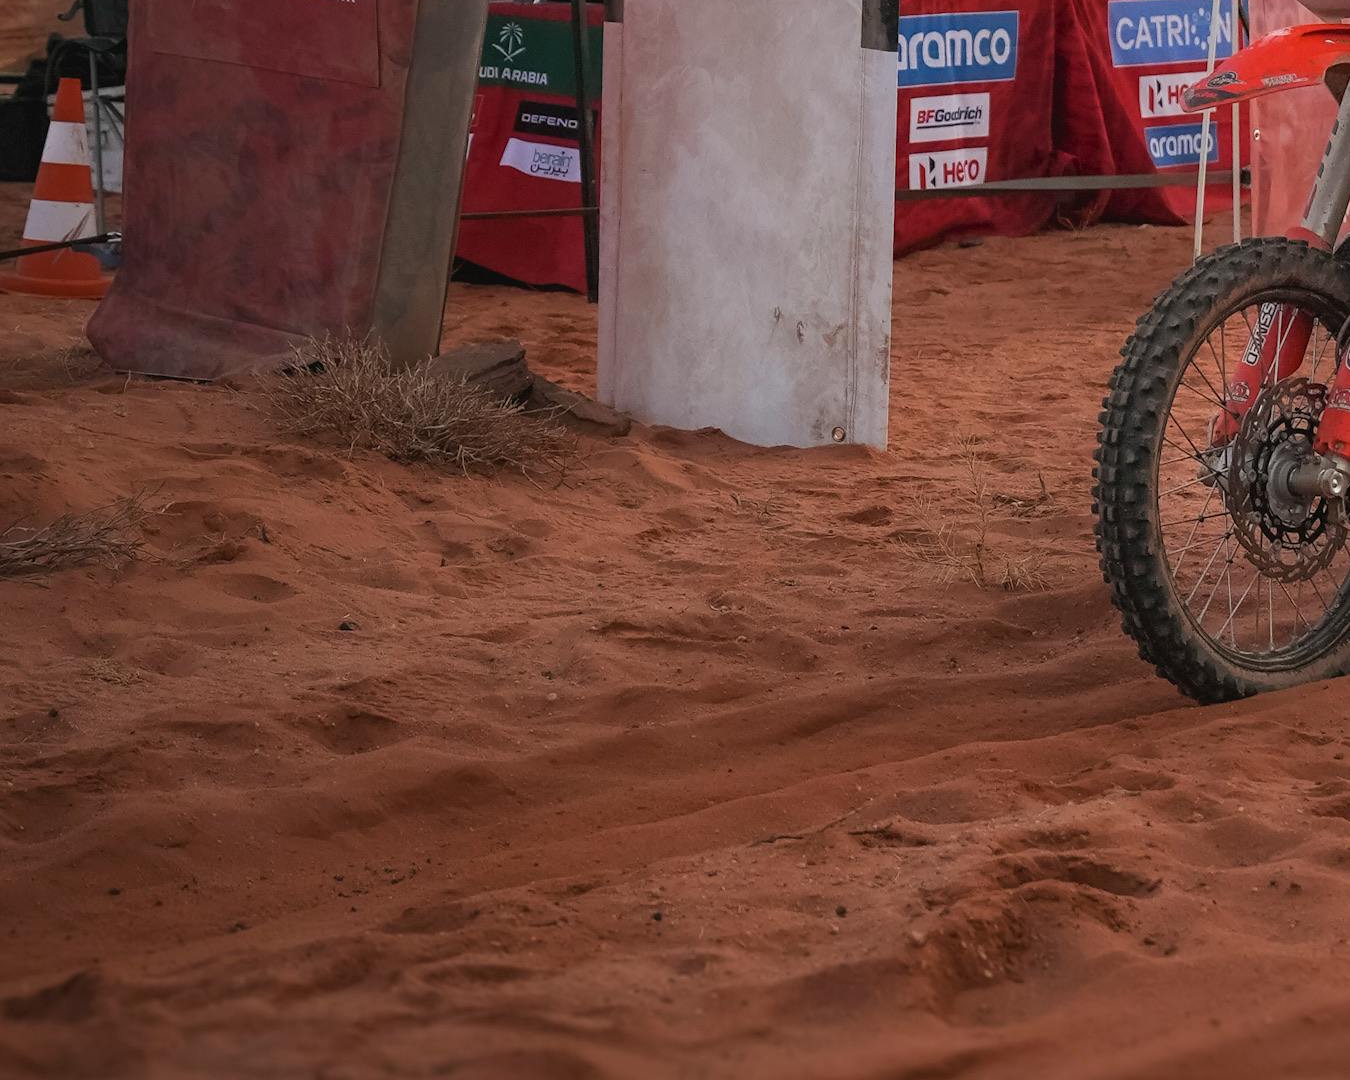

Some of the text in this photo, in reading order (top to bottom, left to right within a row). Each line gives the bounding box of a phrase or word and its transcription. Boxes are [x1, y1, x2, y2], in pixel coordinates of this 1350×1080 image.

[478, 66, 548, 85] UDI ARABIA
[520, 113, 579, 129] DEFEND
[916, 105, 982, 125] BFGoodrich
[533, 148, 572, 167] berain
[943, 159, 980, 184] Hero
